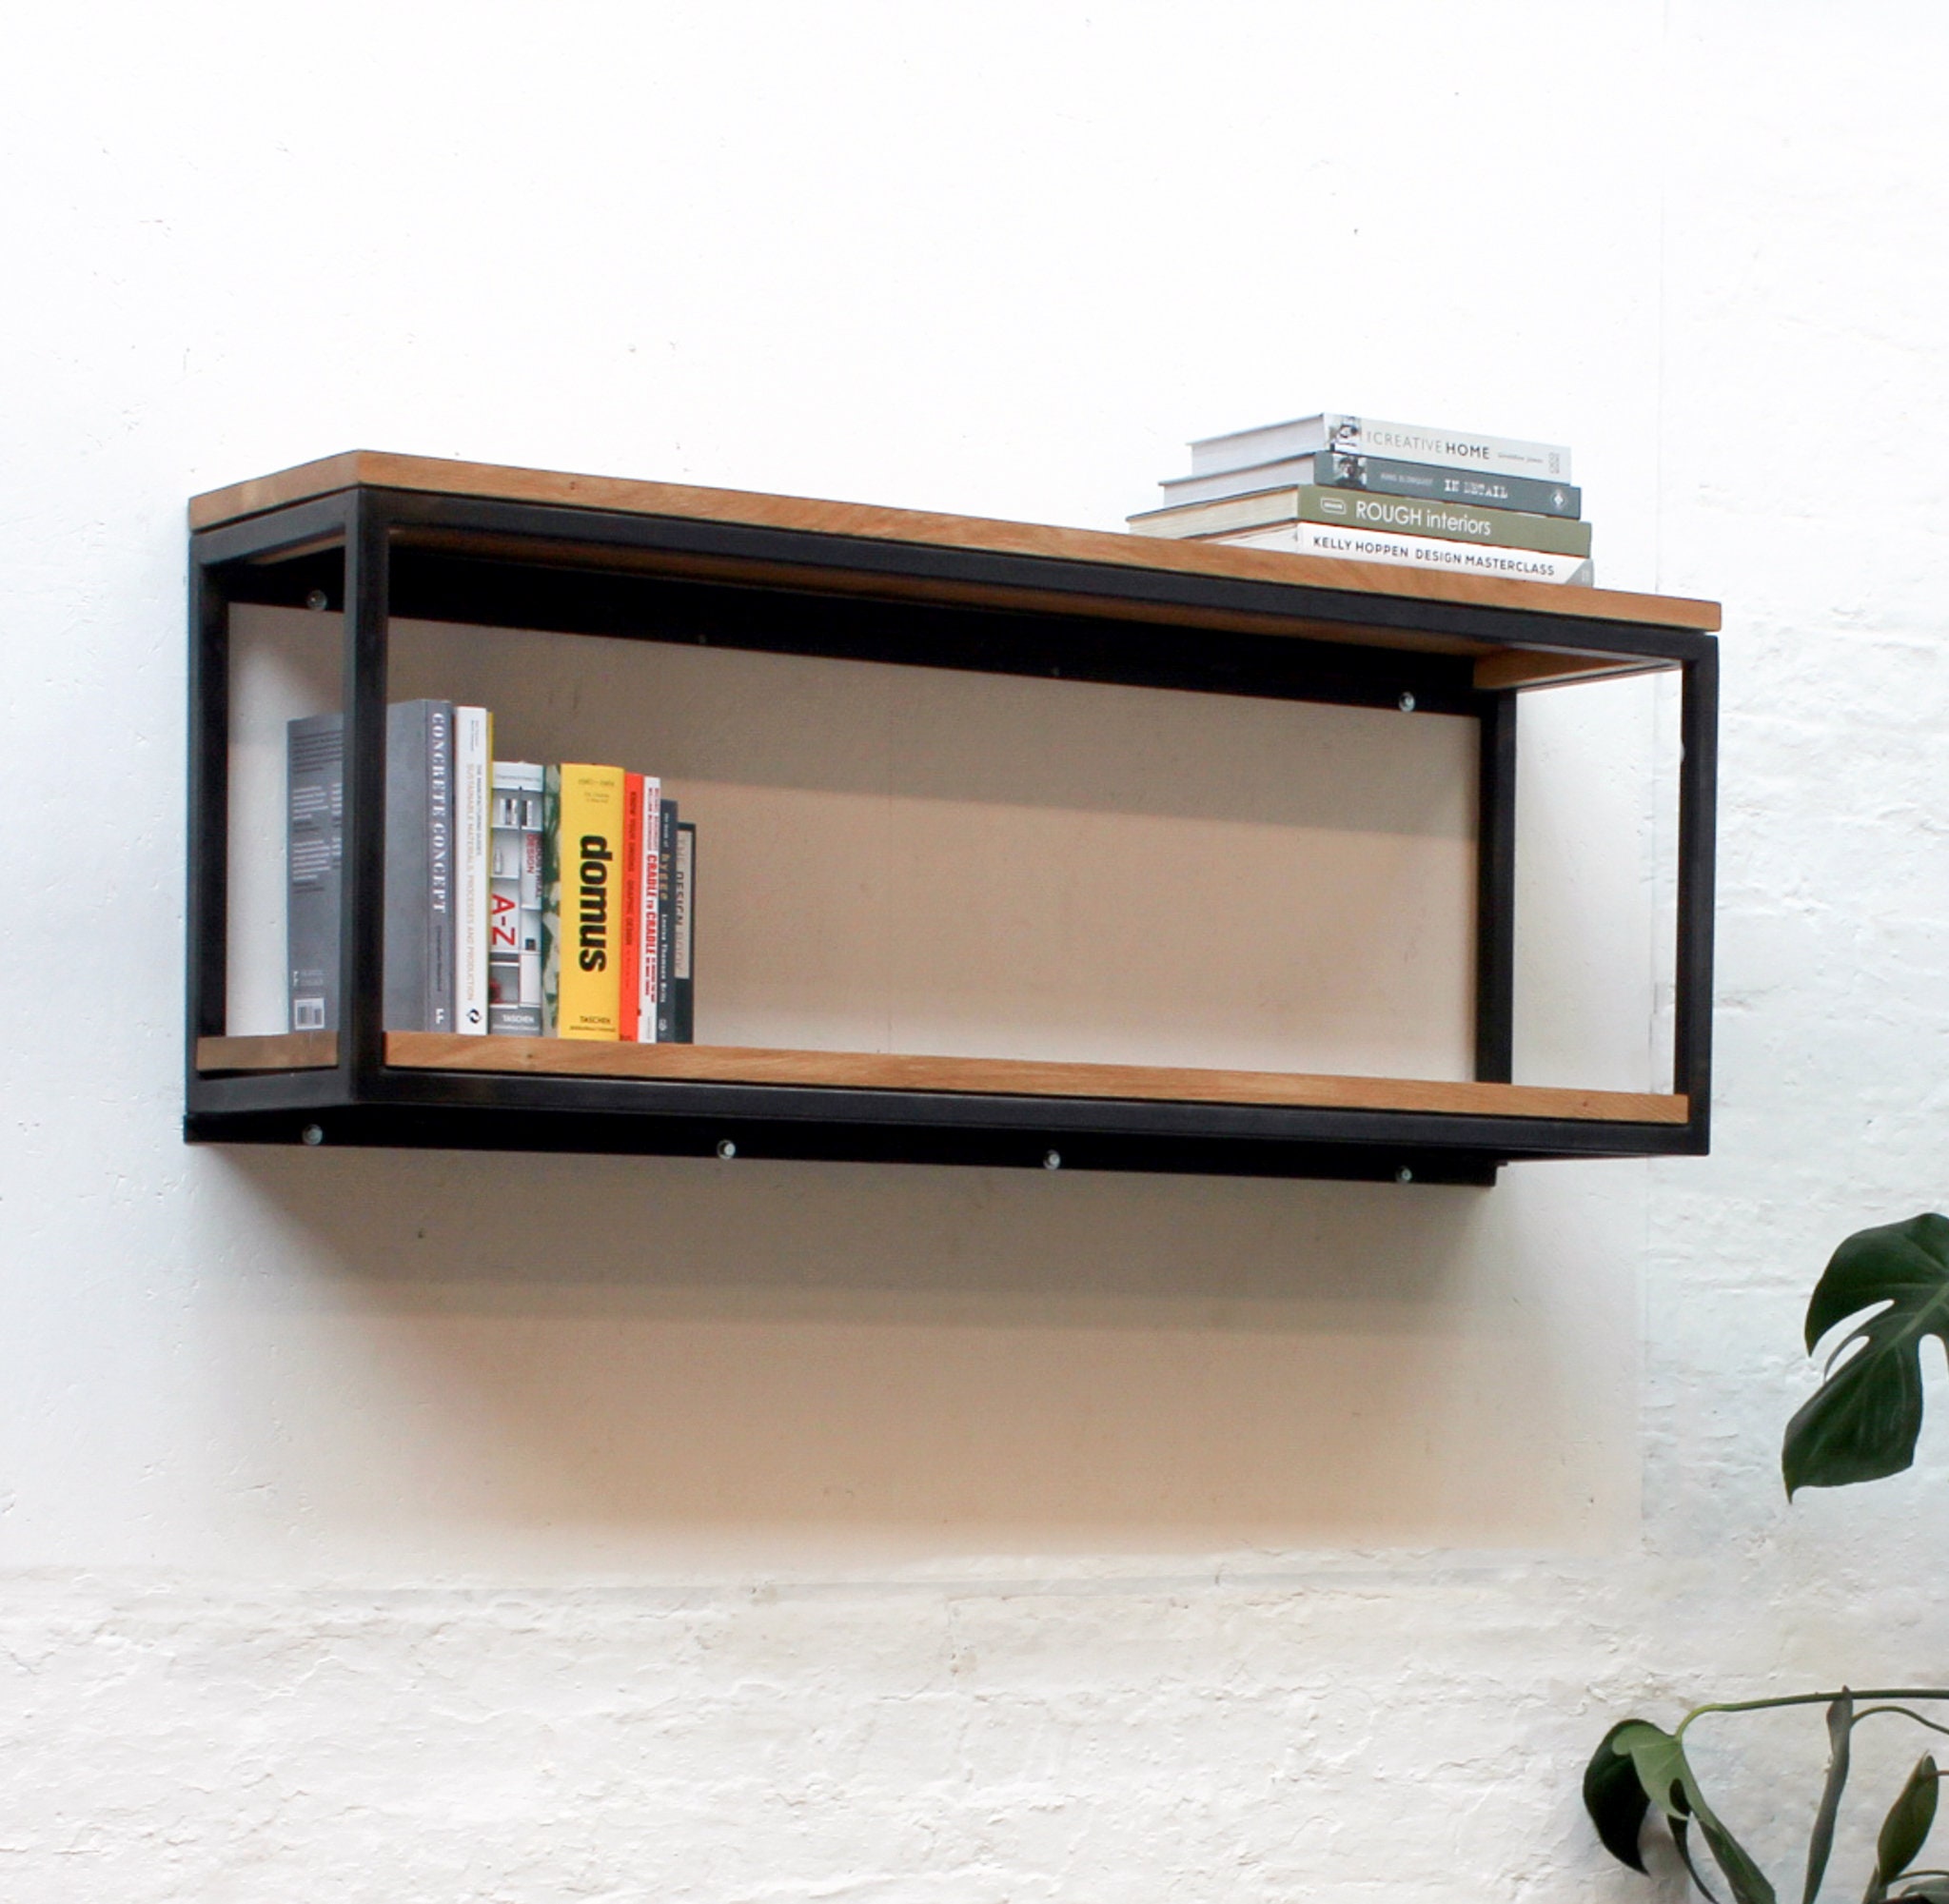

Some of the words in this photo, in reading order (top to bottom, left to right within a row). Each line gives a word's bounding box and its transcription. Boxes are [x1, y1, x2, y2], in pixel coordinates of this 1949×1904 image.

[1373, 432, 1443, 454] CREATIVE
[1446, 442, 1490, 460] HOME
[1444, 479, 1460, 492] IN
[1464, 481, 1507, 499] DETAIL
[1355, 501, 1422, 526] ROUGH
[1427, 510, 1491, 536] interiors
[1313, 536, 1352, 551] KELLY
[1355, 539, 1408, 558] HOPPEN
[1415, 548, 1462, 564] DESIGN
[1465, 555, 1555, 576] MASTERCLASS
[431, 713, 446, 817] CONCRETE
[432, 822, 446, 913] CONCEPT
[526, 834, 535, 873] DESIGN
[647, 854, 658, 897] CRADLE
[491, 893, 516, 946] A-Z
[579, 835, 614, 972] domus
[645, 911, 657, 954] CRADLE
[580, 1015, 611, 1025] TASCHEN
